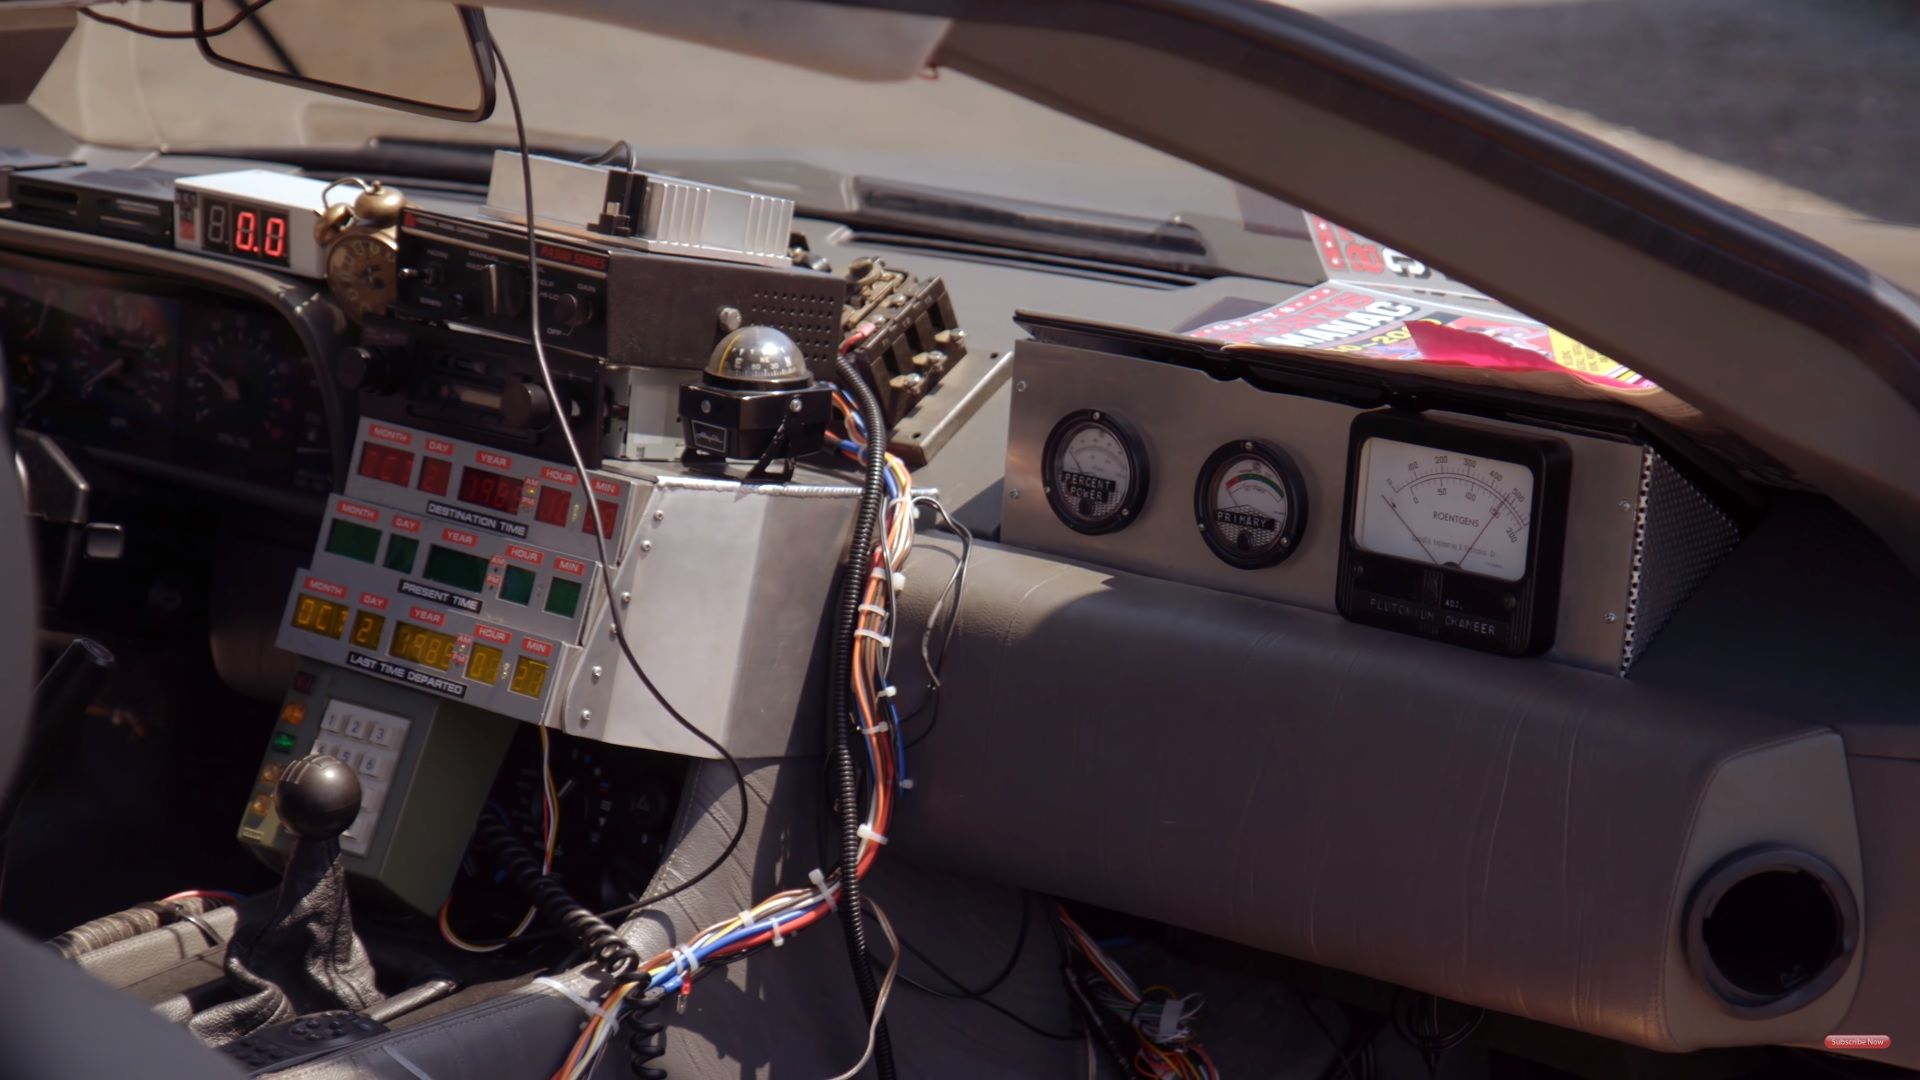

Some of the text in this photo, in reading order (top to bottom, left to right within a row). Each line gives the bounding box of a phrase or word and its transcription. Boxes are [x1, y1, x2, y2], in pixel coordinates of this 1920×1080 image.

[235, 211, 285, 258] 0.0
[538, 279, 555, 287] ELP
[1218, 292, 1374, 343] PORTS
[1264, 301, 1413, 347] MANAC
[373, 427, 408, 441] MONTH
[429, 441, 449, 452] DAY
[480, 454, 507, 466] YEAR
[545, 469, 573, 482] HOUR
[1065, 473, 1110, 489] PERCENT
[595, 481, 616, 492] MIN
[1071, 486, 1102, 500] POWER
[342, 504, 375, 518] MONTH
[395, 519, 417, 529] DAY
[428, 503, 526, 536] DESTINATION TIME
[1217, 512, 1266, 526] PRIMARY
[1433, 511, 1480, 528] ROENTGENS
[447, 531, 473, 544] YEAR
[511, 548, 538, 561] HOUR
[559, 561, 578, 572] MIN
[310, 580, 343, 595] MONTH
[363, 595, 384, 607] DAY
[402, 582, 478, 610] PRESENT TIME
[414, 609, 440, 622] YEAR
[1370, 598, 1495, 636] PLUTONIUM CHAMBER
[480, 628, 505, 641] HOUR
[527, 641, 546, 652] MIN
[350, 654, 463, 695] LAST TIME DEPARTED
[352, 721, 360, 732] 2
[375, 728, 384, 739] 3
[343, 751, 350, 761] 5
[366, 759, 374, 770] 6
